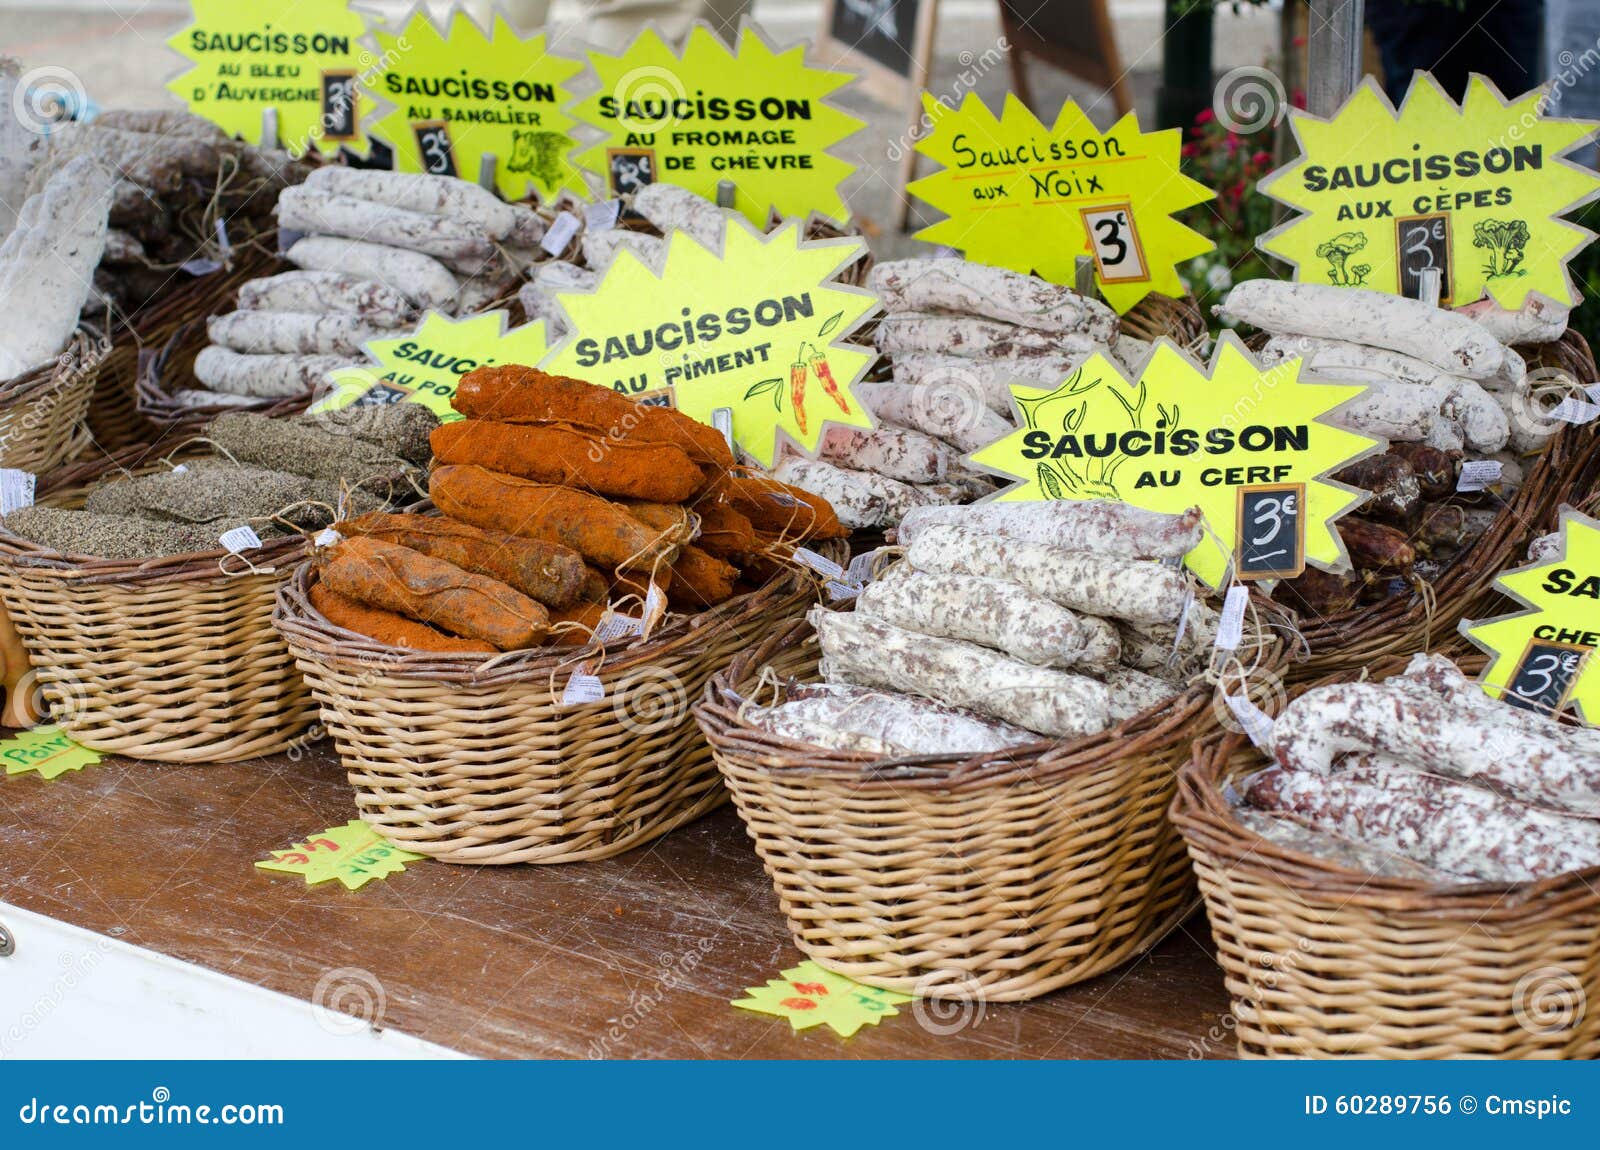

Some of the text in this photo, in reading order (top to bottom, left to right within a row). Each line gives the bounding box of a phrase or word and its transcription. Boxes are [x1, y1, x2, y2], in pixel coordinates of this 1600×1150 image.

[217, 63, 300, 77] AU BLEU
[408, 106, 431, 119] AU
[625, 130, 796, 146] AU FROMAGE
[665, 156, 696, 170] DE
[952, 134, 1126, 169] Saucisson
[973, 170, 1104, 200] aux Noix
[1336, 200, 1393, 221] AUX
[1406, 220, 1445, 276] 3€
[380, 372, 414, 385] AU
[613, 373, 647, 396] AU
[1134, 465, 1293, 489] AU CERF
[1253, 495, 1298, 545] 3€
[1517, 655, 1580, 696] 3€
